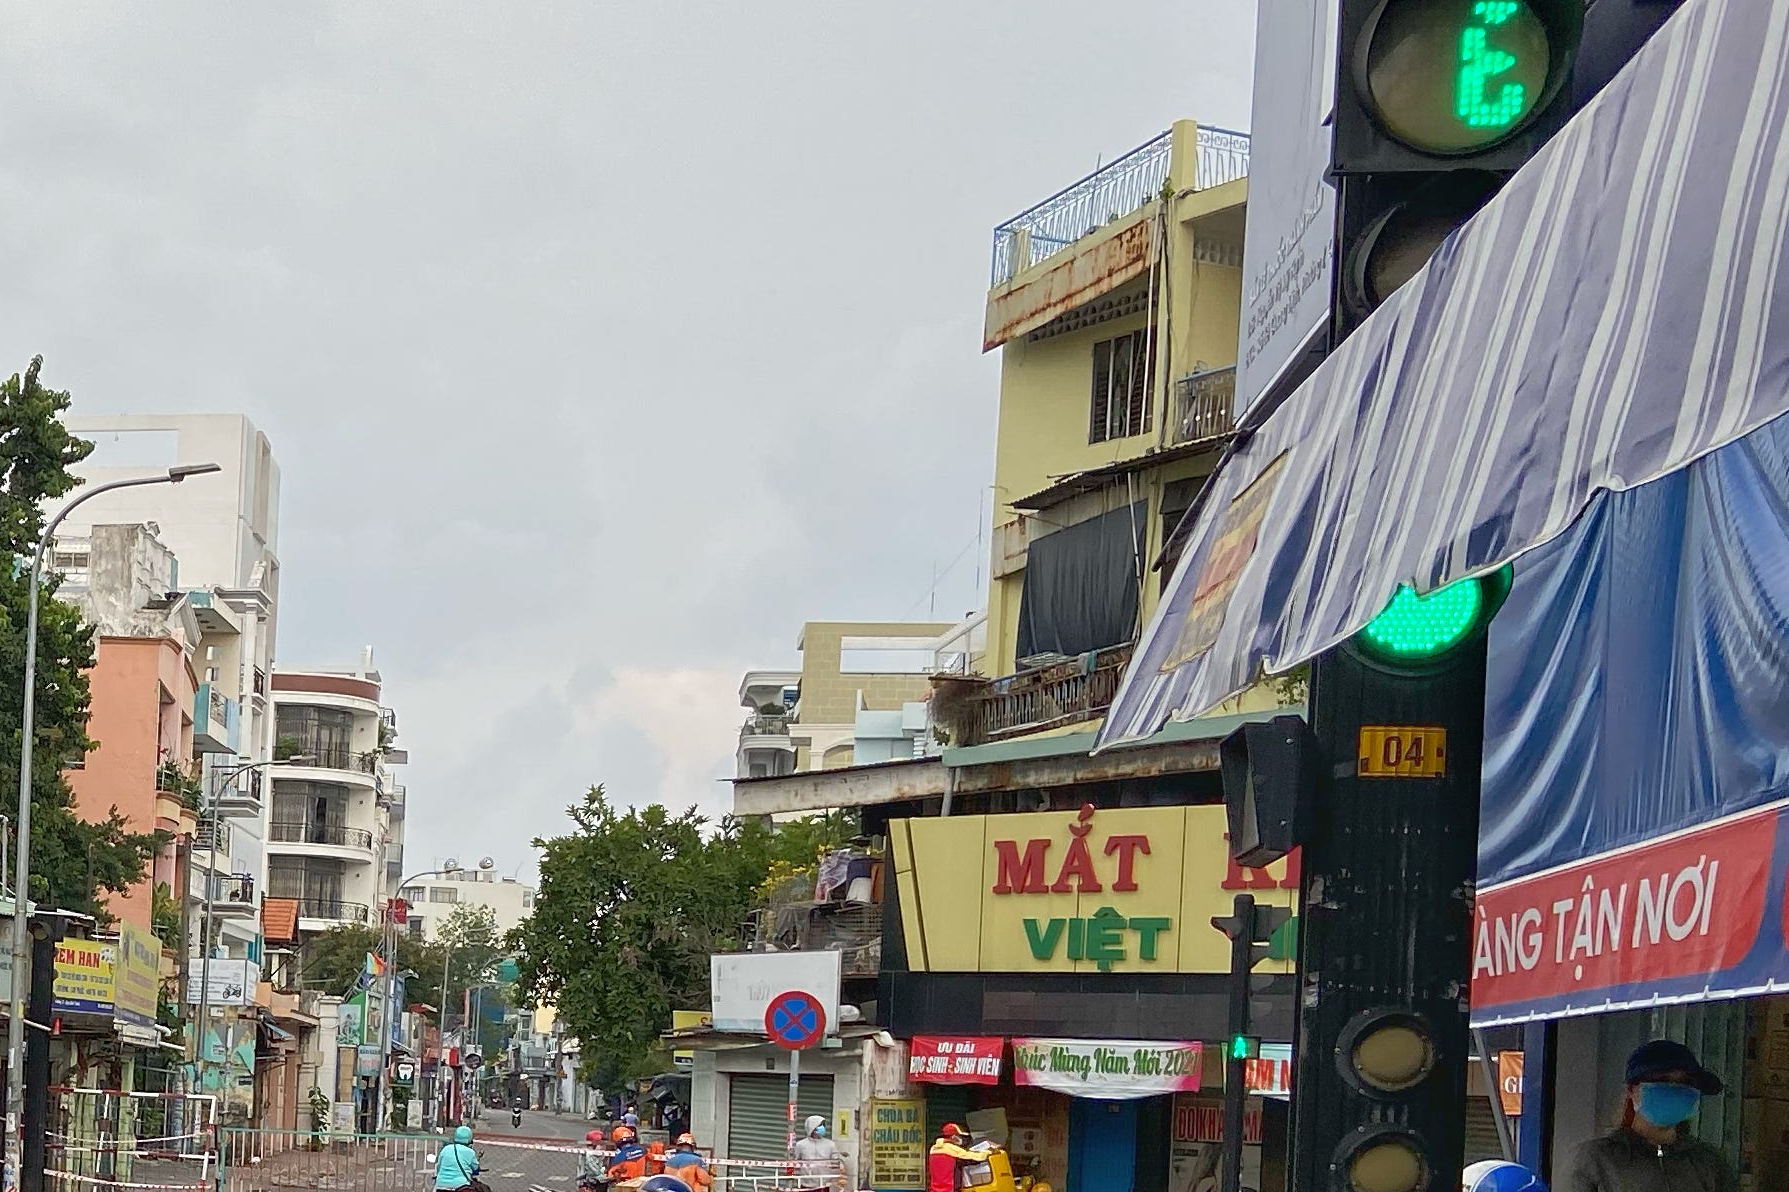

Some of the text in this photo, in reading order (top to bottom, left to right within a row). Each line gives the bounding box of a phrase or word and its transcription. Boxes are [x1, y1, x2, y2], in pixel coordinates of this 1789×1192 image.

[1382, 734, 1425, 770] 04
[991, 802, 1152, 895] MẮT
[1022, 906, 1173, 971] VIỆT
[1552, 874, 1628, 981] TẬN
[1632, 854, 1719, 949] NƠI
[926, 1056, 949, 1074] SINH
[954, 1056, 977, 1075] SINH
[977, 1054, 1000, 1077] VIÊN
[1049, 1046, 1091, 1081] Mừng
[1094, 1047, 1130, 1075] Năm
[1134, 1048, 1162, 1076] Mới
